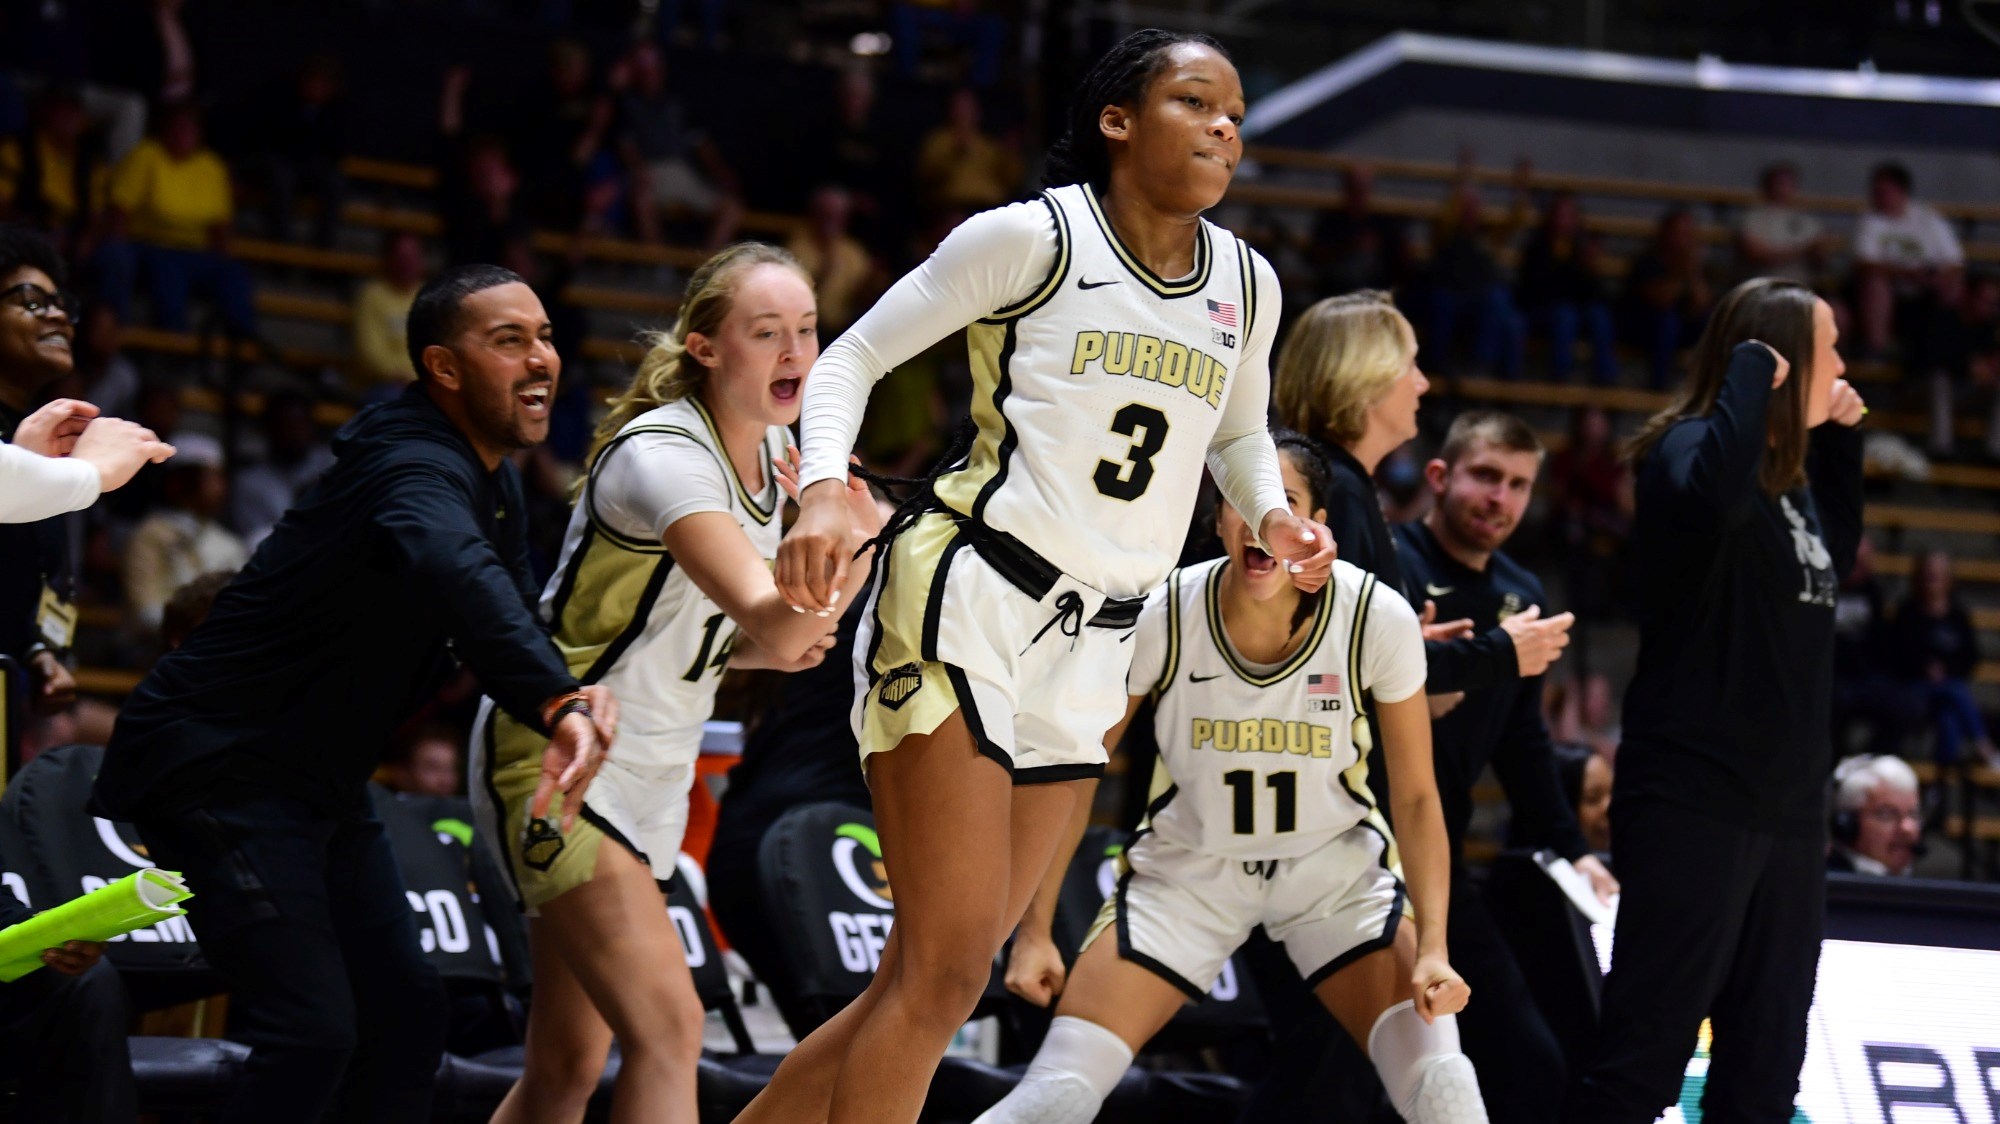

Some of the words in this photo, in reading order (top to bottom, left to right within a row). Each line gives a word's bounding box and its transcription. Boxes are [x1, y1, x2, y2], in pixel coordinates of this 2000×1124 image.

[1070, 330, 1228, 410] PURDUE
[1091, 400, 1170, 502] 3
[1191, 718, 1332, 759] PURDUE
[1223, 769, 1297, 835] 11
